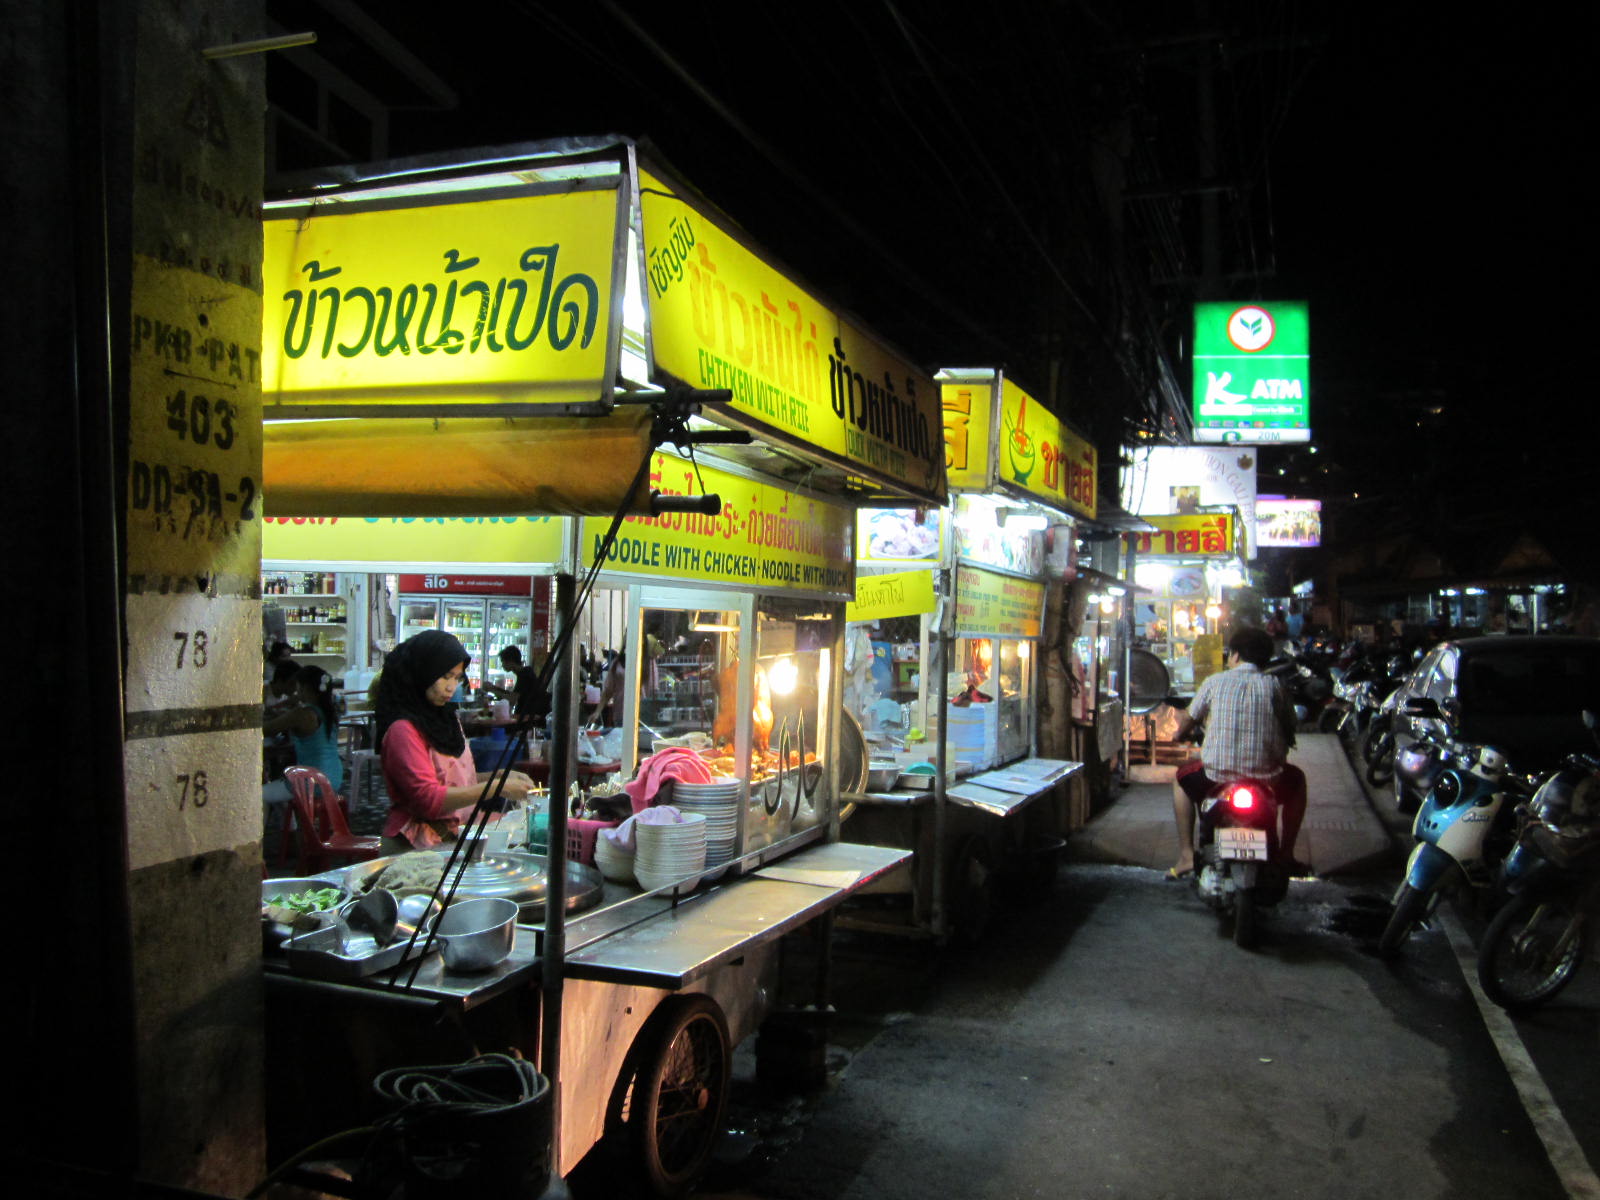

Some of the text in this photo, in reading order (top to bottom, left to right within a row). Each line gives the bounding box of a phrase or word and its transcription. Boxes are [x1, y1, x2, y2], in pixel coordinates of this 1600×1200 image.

[283, 243, 599, 359] ข้าวหน้าเป็ด
[698, 348, 753, 406] CHICKEN
[756, 378, 788, 423] WITH
[1251, 379, 1302, 400] ATM
[166, 390, 235, 450] 403
[594, 534, 849, 588] NOODLE WITH CHICKEN NOODLE WITH DUCK
[174, 630, 207, 669] 78
[176, 770, 208, 811] 78
